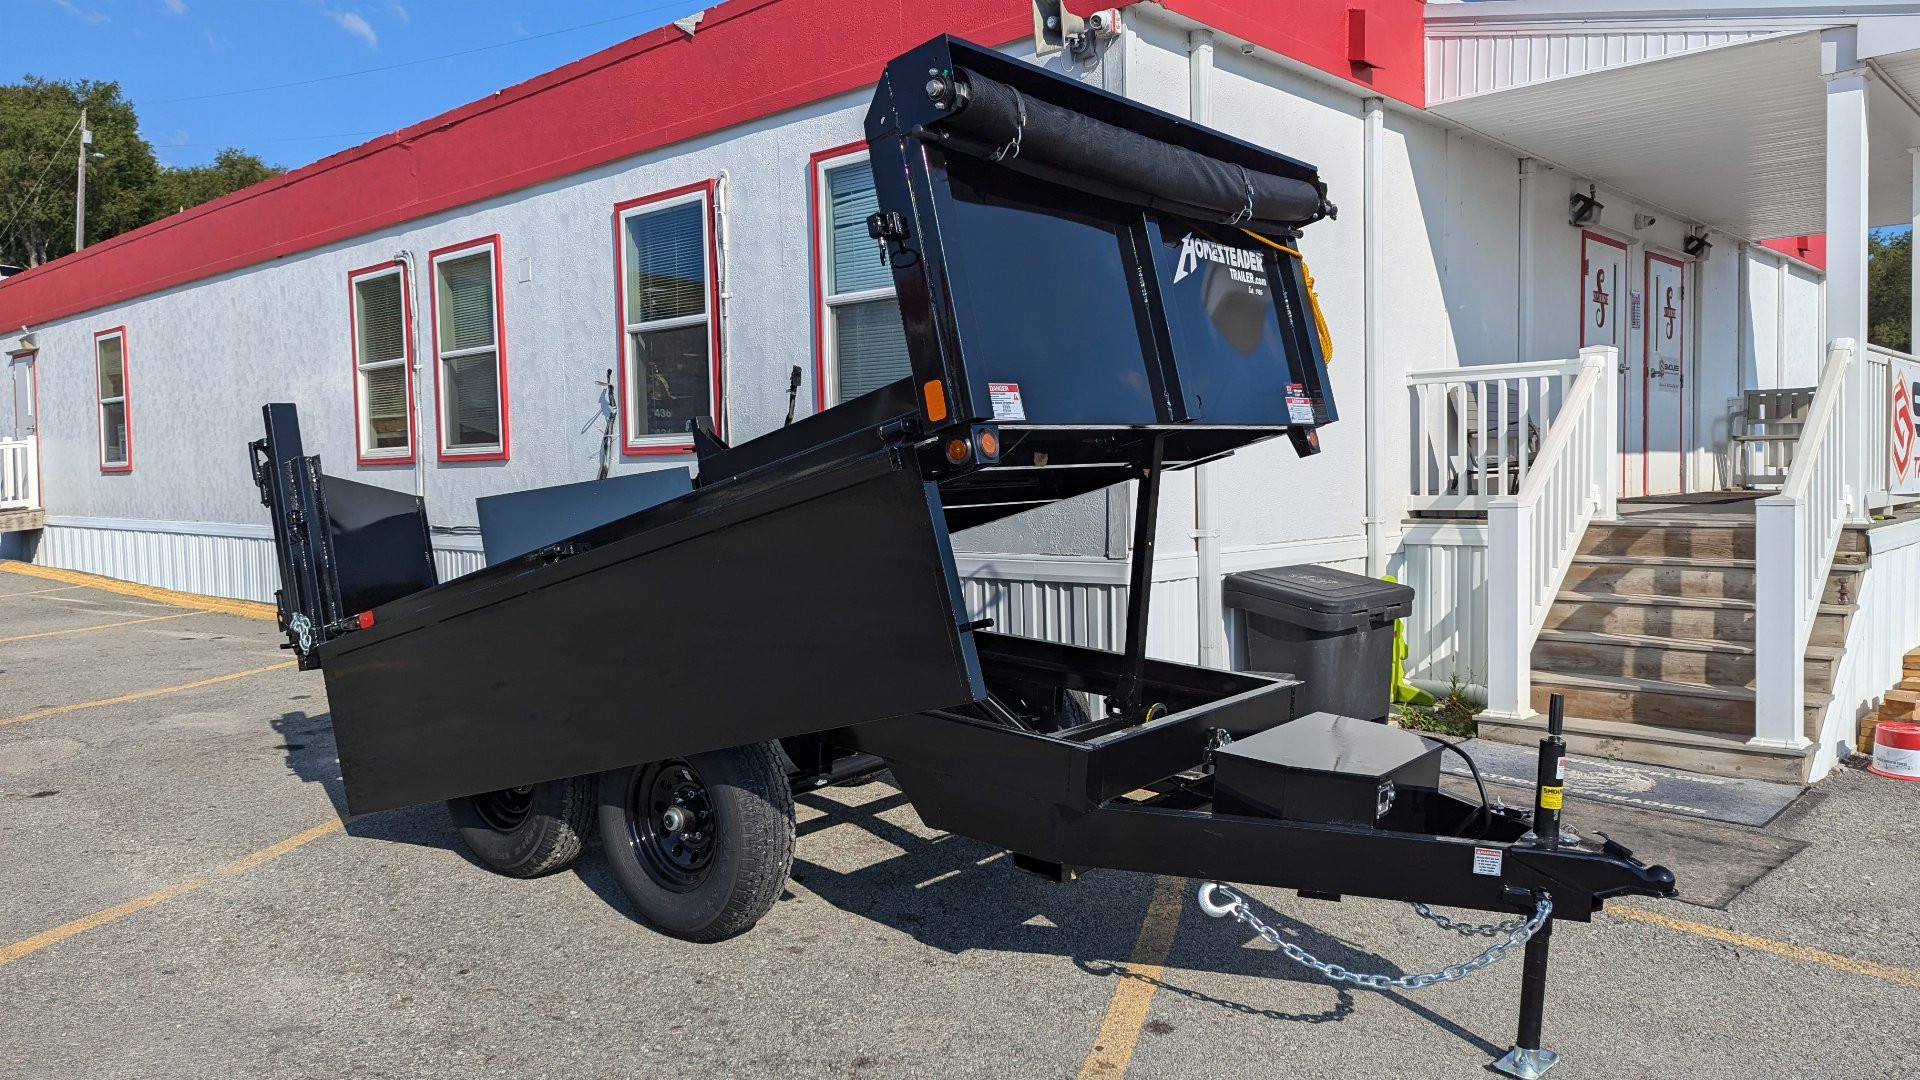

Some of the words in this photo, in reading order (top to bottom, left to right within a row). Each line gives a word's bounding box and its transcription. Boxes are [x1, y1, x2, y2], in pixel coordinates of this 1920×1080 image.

[1173, 231, 1264, 284] HOMESTEADER
[1229, 267, 1267, 287] TRAILER.com
[655, 409, 671, 417] 436
